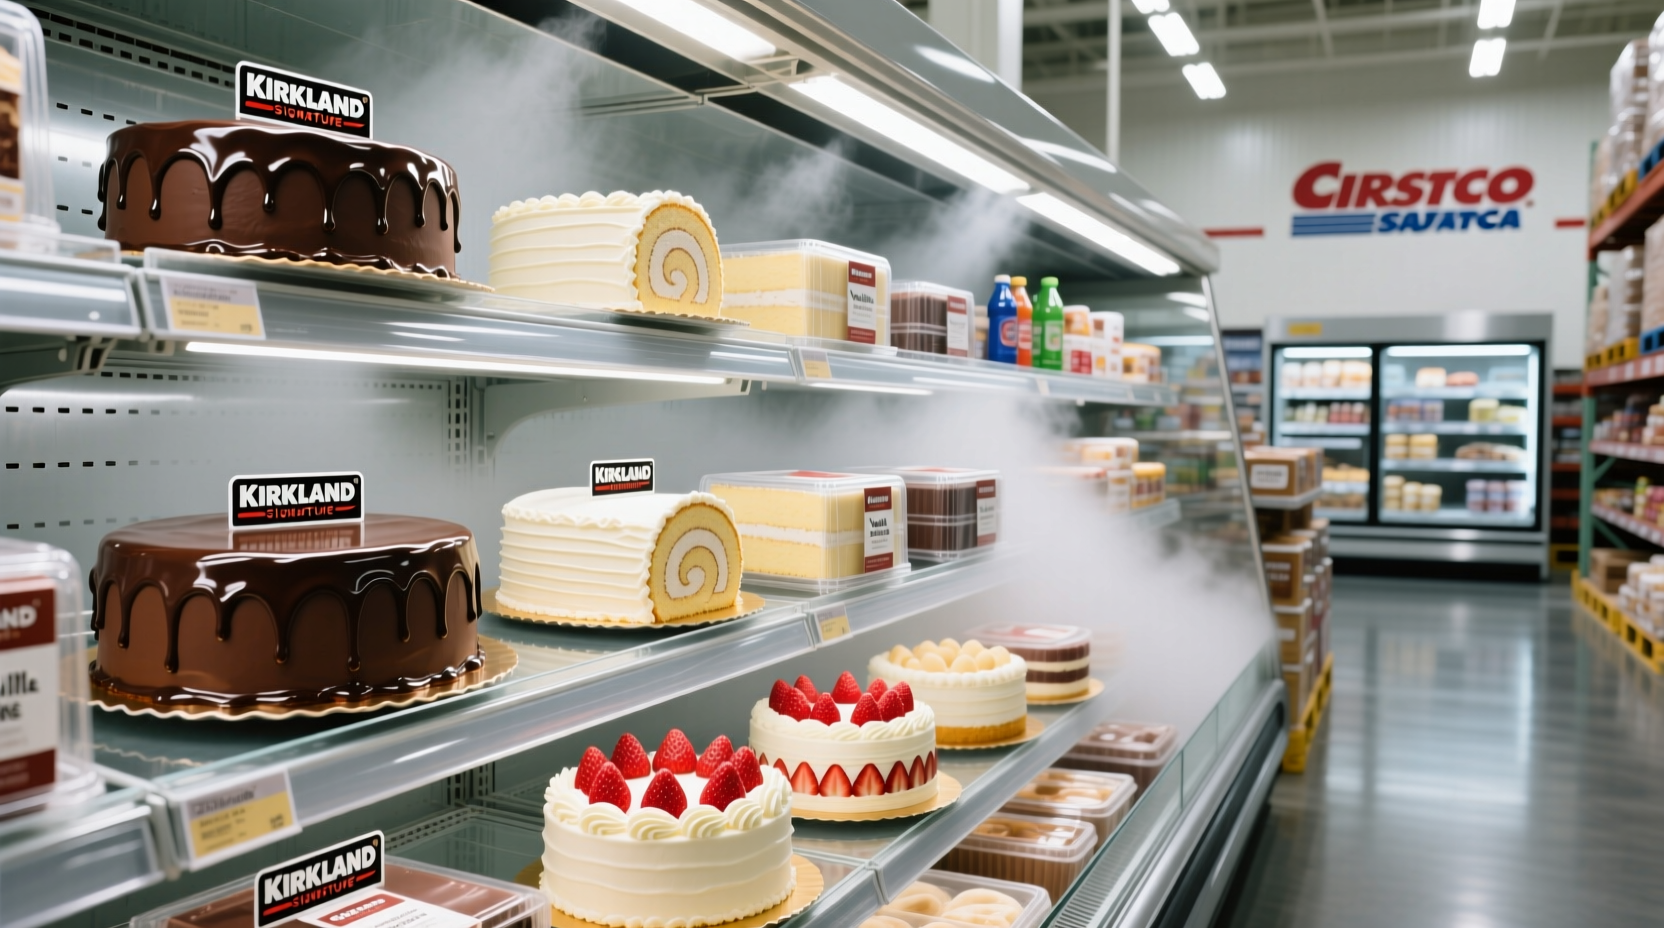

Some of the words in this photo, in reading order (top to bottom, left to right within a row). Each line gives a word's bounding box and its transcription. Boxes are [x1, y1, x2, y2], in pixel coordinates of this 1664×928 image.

[246, 72, 365, 118] KIRKLAND
[1293, 162, 1534, 209] CIRSTCO
[240, 482, 356, 508] KIRKLAND
[265, 845, 376, 905] KIRKLAND
